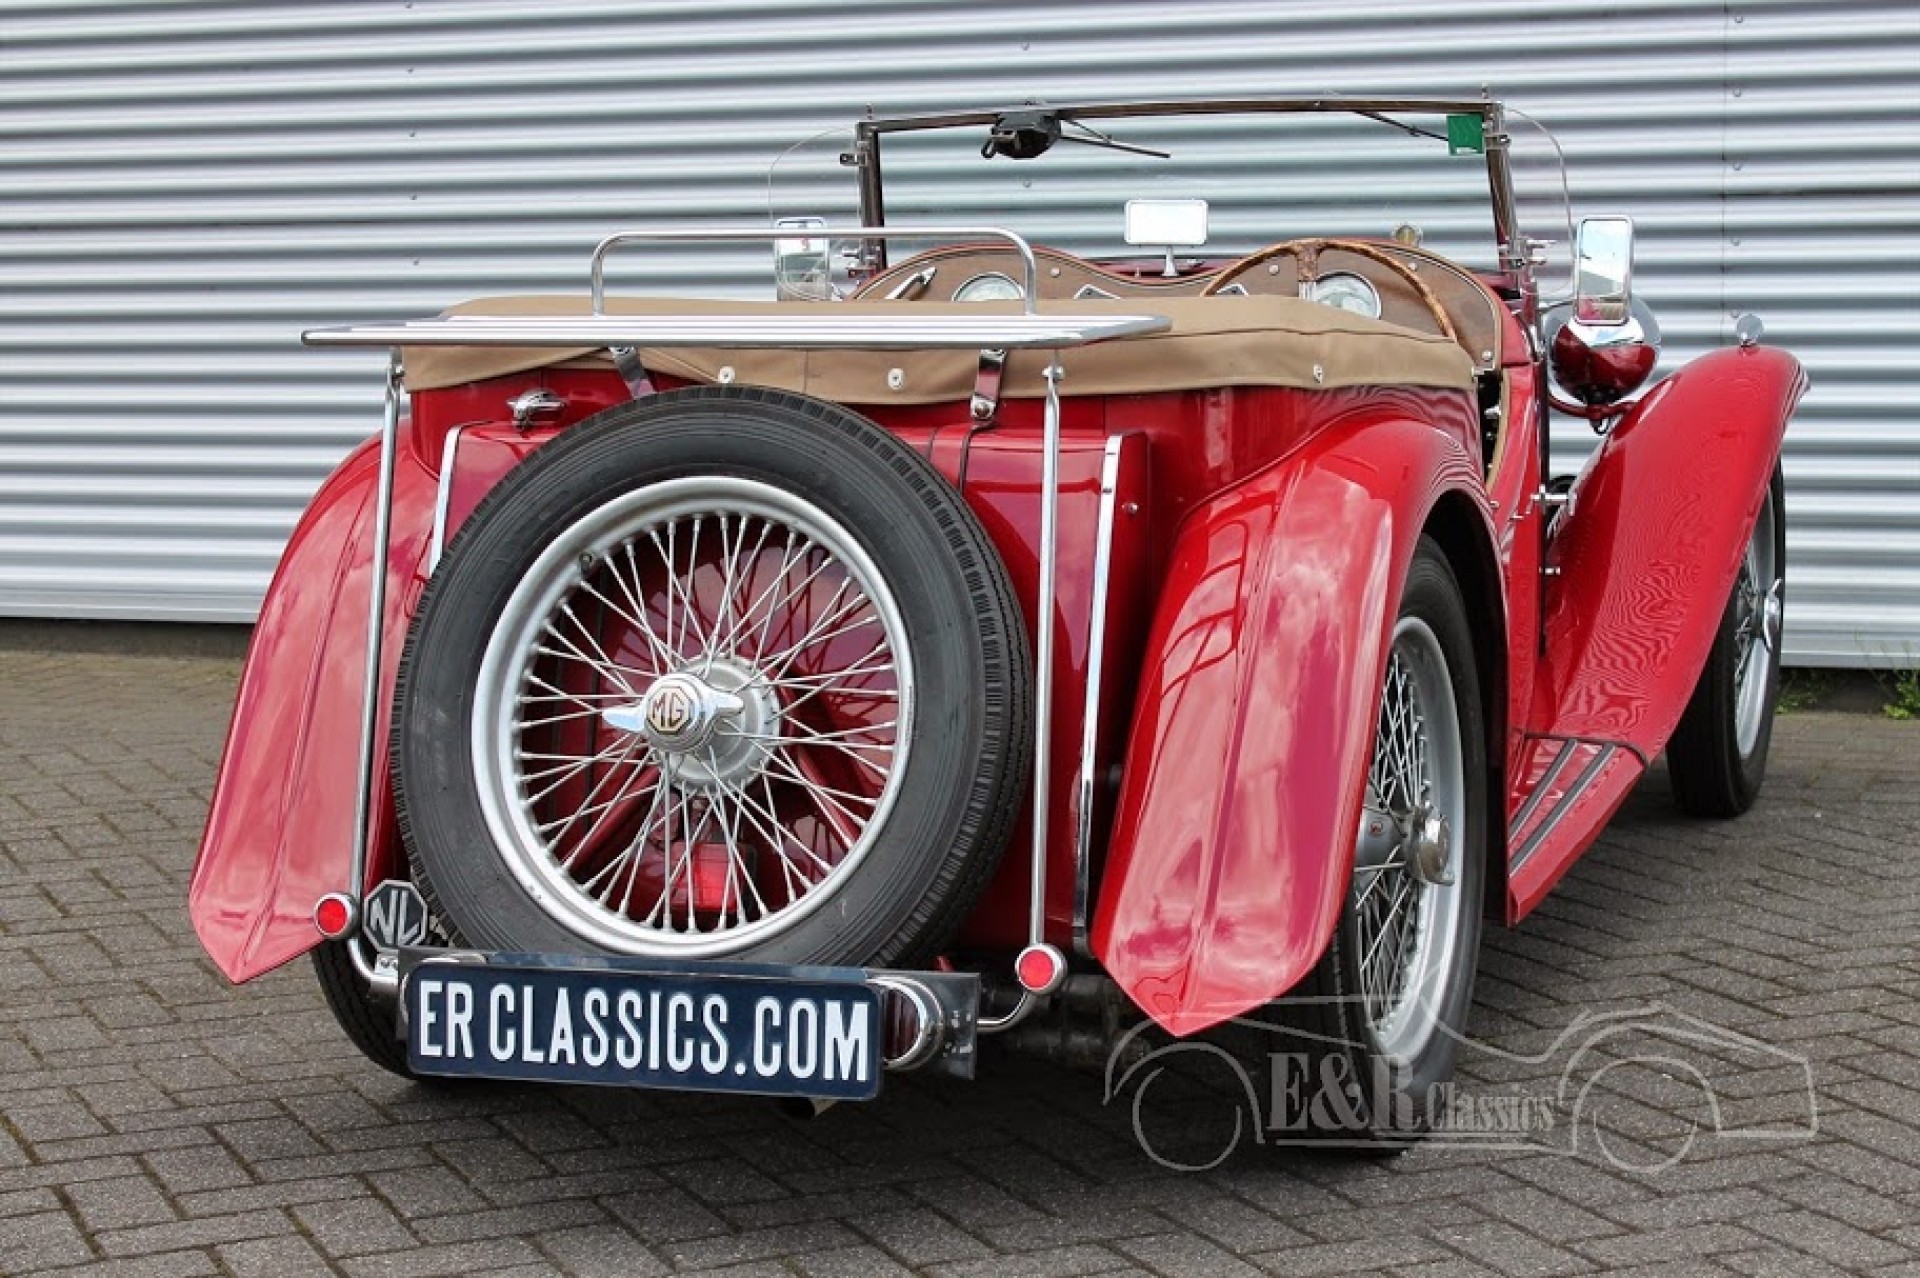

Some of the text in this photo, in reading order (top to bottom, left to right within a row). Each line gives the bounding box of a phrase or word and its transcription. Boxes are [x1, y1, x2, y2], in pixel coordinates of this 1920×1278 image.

[652, 691, 685, 728] MG
[370, 888, 420, 946] NL
[418, 980, 869, 1082] ER CLASSICS.COM
